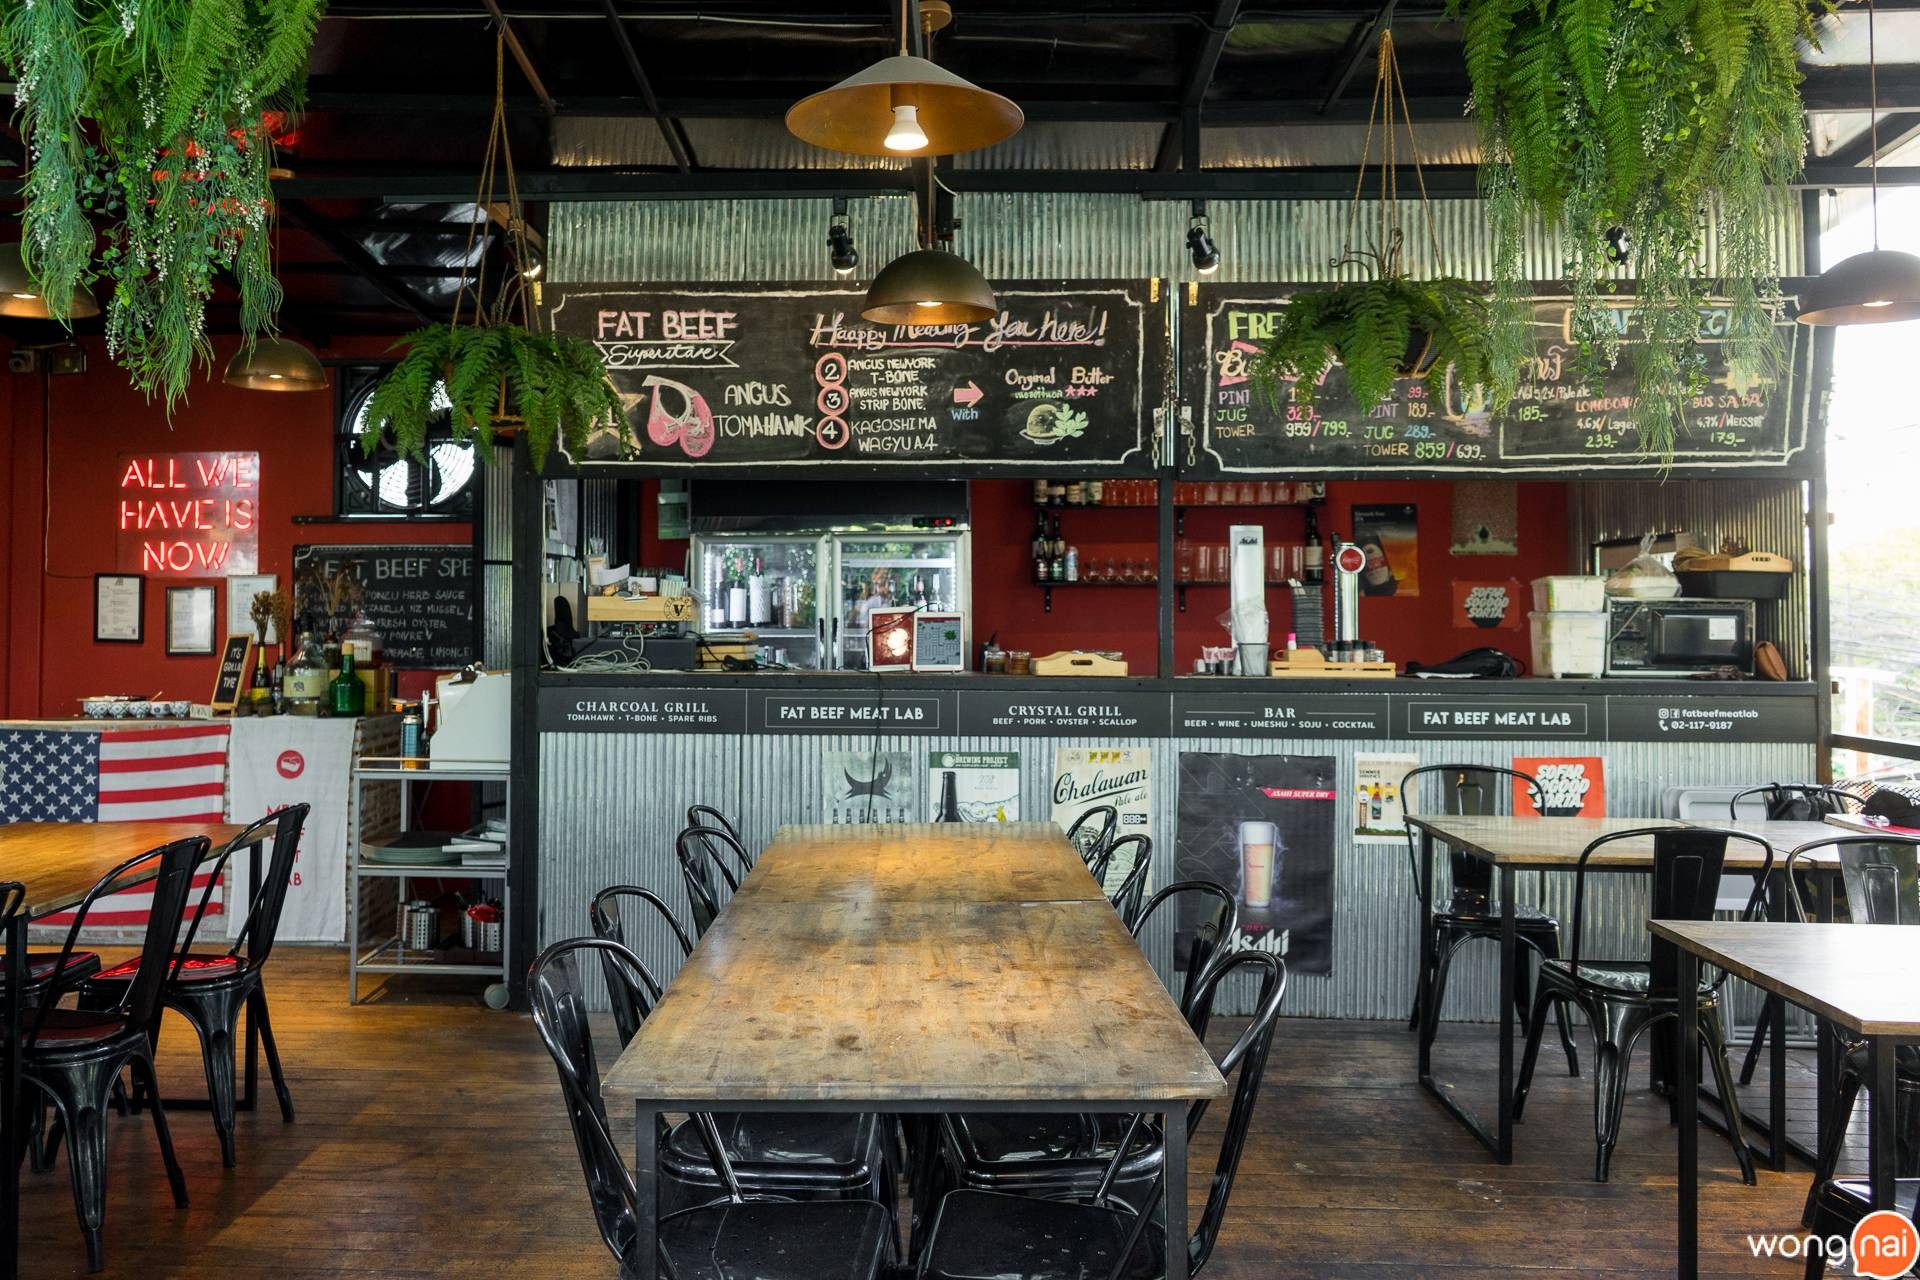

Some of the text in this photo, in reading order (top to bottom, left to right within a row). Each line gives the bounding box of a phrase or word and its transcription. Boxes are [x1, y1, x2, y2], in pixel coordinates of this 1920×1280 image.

[598, 309, 740, 340] FAT BEEF
[848, 357, 936, 371] ANGUS NEWYORK
[825, 363, 840, 381] 2
[870, 371, 919, 385] T-BONE
[1071, 366, 1115, 385] Butter
[724, 381, 792, 407] ANGUS
[849, 385, 928, 399] ANGUS NEWYORK
[1218, 390, 1250, 405] PINT
[826, 392, 841, 408] 3
[860, 399, 889, 411] STRIP
[951, 408, 979, 421] With
[1216, 407, 1247, 421] JUG
[1368, 403, 1399, 418] PINT
[713, 412, 816, 438] TOMAHAWK
[822, 422, 839, 440] 4
[1215, 424, 1255, 438] TOWER
[1363, 425, 1394, 440] JUG
[858, 436, 912, 452] WAGYU
[1363, 443, 1409, 456] TOWER
[121, 458, 252, 488] ALL WE
[121, 499, 254, 529] HAVE IS
[143, 541, 231, 571] NOW
[325, 559, 369, 579] FT
[375, 558, 432, 579] BEEF
[576, 701, 709, 713] CHARCOAL GRILL
[780, 706, 924, 720] FAT BEEF MEAT LAB
[1008, 705, 1122, 717] CRYSTAL GRILL
[1264, 707, 1296, 719] BAR
[1682, 709, 1759, 718] fatbeefmeatlab
[567, 714, 718, 723] TOMAHAWK T-BONE SPARE RIBS
[1056, 718, 1089, 726] OYSTER
[1099, 718, 1137, 726] SCALLOP
[1184, 719, 1375, 729] BEER WINE UMESHU SOJU COCKTAIL
[1423, 711, 1571, 726] FAT BEEF MEAT LAB
[1671, 720, 1733, 730] 02-117-9187
[1053, 769, 1148, 805] Chalawan
[1225, 927, 1290, 956] Asahi
